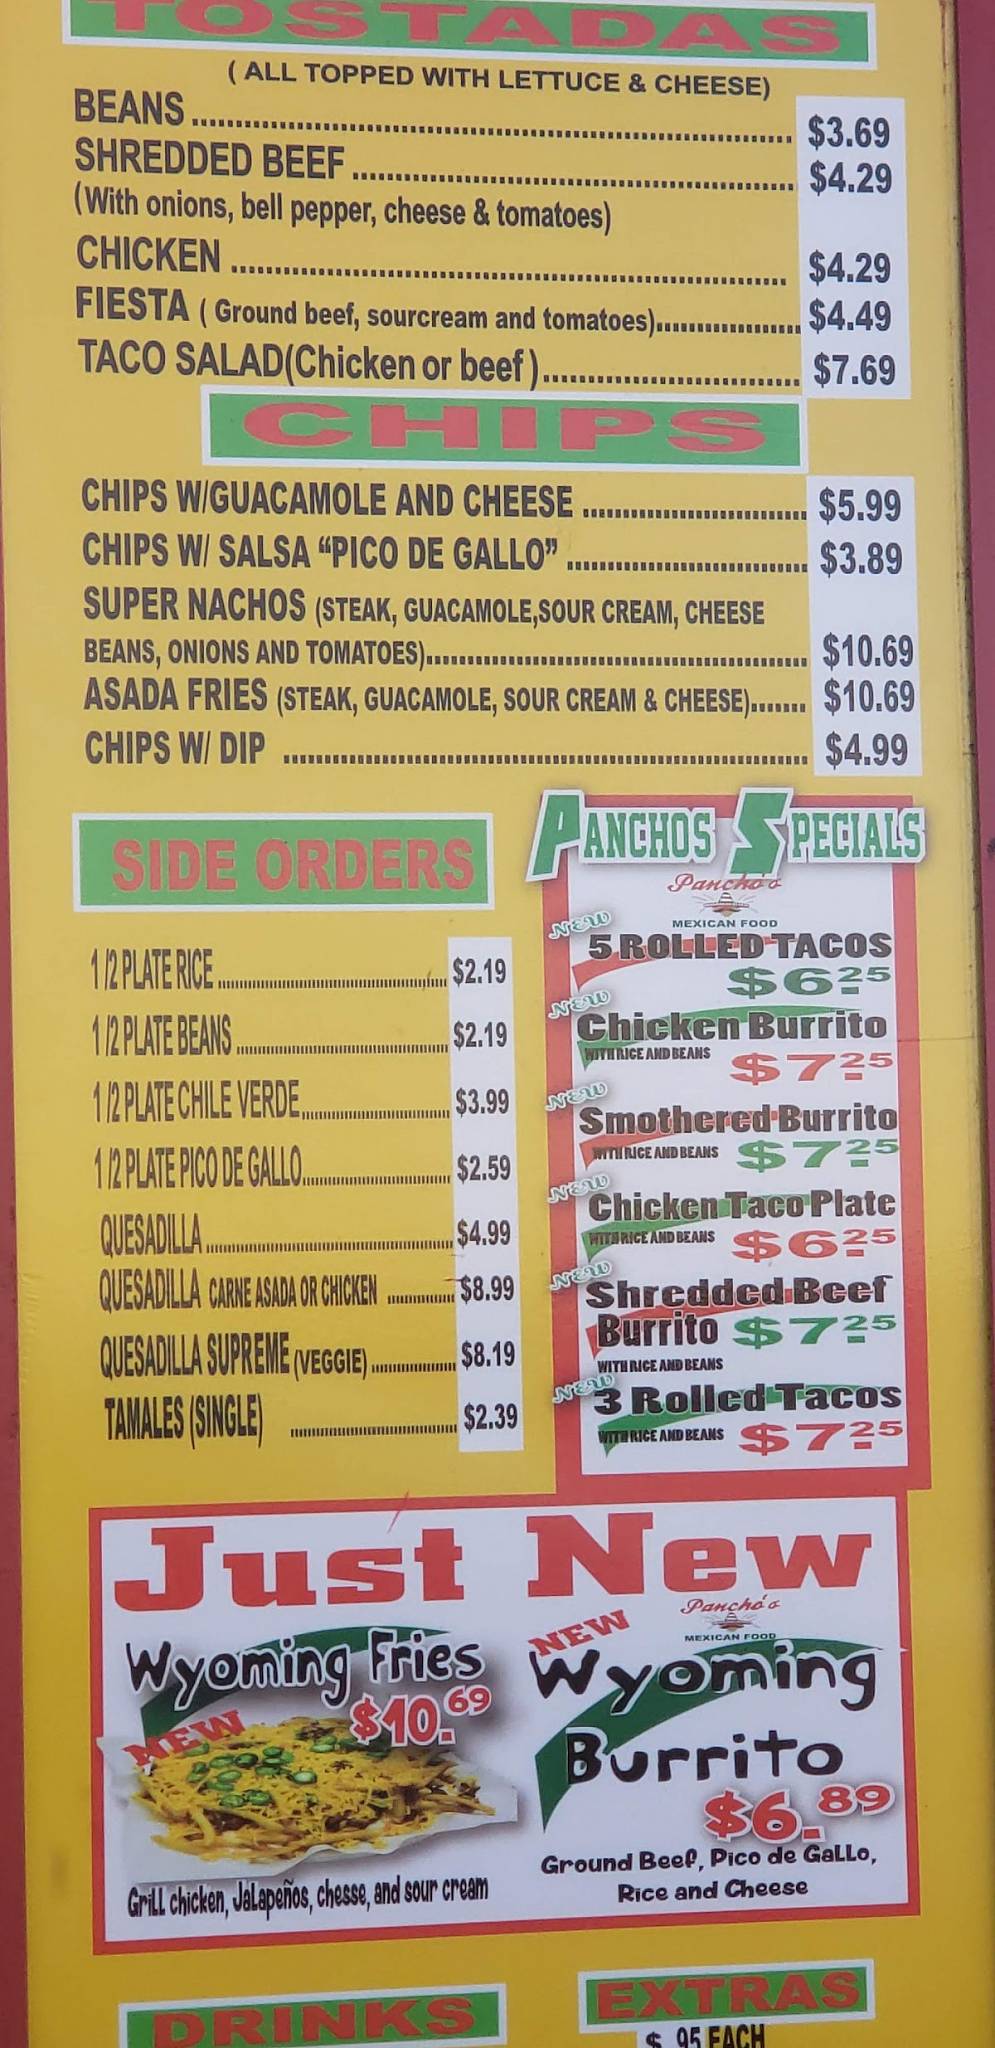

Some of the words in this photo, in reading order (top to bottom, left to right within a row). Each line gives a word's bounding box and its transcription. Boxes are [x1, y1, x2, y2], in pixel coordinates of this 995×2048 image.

[87, 0, 840, 53] TOSTADAS
[244, 61, 296, 81] ALL
[304, 63, 414, 85] TOPPED
[500, 70, 620, 92] LETTUCE
[655, 75, 770, 101] CHEESE)
[75, 88, 184, 126] BEANS
[808, 114, 889, 151] $3.69
[75, 137, 252, 176] SHREDDED
[263, 144, 344, 179] BEEF
[810, 160, 892, 196] $4.29
[75, 181, 138, 215] (With
[147, 189, 233, 224] onions,
[242, 191, 282, 220] bell
[291, 200, 376, 229] pepper,
[384, 196, 465, 225] cheese
[77, 235, 220, 272] CHICKEN
[809, 249, 890, 286] $4.29
[76, 286, 189, 321] FIESTA
[215, 299, 296, 324] Ground
[305, 301, 359, 331] beef,
[368, 309, 487, 328] sourcream
[496, 306, 535, 329] and
[809, 298, 891, 334] $4.49
[78, 339, 165, 375] TACO
[422, 356, 452, 380] or
[461, 348, 524, 382] beef
[814, 352, 895, 388] $7.69
[243, 402, 767, 454] CHIPS
[82, 478, 167, 512] CHIPS
[396, 484, 453, 516] AND
[464, 484, 573, 518] CHEESE
[819, 487, 901, 525] $5.99
[83, 532, 168, 567] CHIPS
[219, 534, 311, 568] SALSA
[409, 537, 443, 569] DE
[820, 540, 902, 578] $3.89
[84, 586, 179, 620] SUPER
[189, 588, 305, 621] NACHOS
[316, 597, 397, 628] (STEAK,
[602, 599, 678, 629] CREAM,
[685, 600, 764, 624] CHEESE
[85, 639, 160, 670] BEANS,
[168, 639, 249, 664] ONIONS
[256, 640, 299, 664] AND
[823, 632, 913, 671] $10.69
[84, 677, 179, 710] ASADA
[188, 678, 267, 711] FRIES
[278, 687, 357, 717] (STEAK,
[365, 687, 497, 717] GUACAMOLE,
[504, 688, 560, 711] SOUR
[566, 688, 636, 712] CREAM
[665, 688, 749, 719] CHEESE)
[824, 678, 914, 716] $10.69
[86, 731, 170, 764] CHIPS
[220, 731, 265, 764] DIP
[826, 731, 907, 770] $4.99
[533, 795, 711, 876] PANCHOS
[730, 793, 920, 874] SPECIALS
[112, 838, 237, 892] SIDE
[256, 837, 474, 890] ORDERS
[673, 920, 735, 928] MEXICAN
[588, 934, 612, 960] 5
[620, 934, 765, 960] ROLLED
[771, 932, 892, 959] TACOS
[123, 949, 172, 990] PLATE
[176, 948, 213, 990] RICE
[453, 957, 506, 987] $2.19
[124, 1015, 173, 1056] PLATE
[178, 1014, 231, 1055] BEANS
[454, 1021, 507, 1051] $2.19
[577, 1013, 740, 1042] Chicken
[749, 1011, 887, 1040] Burrito
[125, 1081, 174, 1122] PLATE
[178, 1080, 232, 1119] CHILE
[237, 1080, 300, 1118] VERDE
[456, 1088, 509, 1118] $3.99
[579, 1106, 771, 1134] Smothered
[779, 1103, 898, 1132] Burrito
[126, 1147, 175, 1189] PLATE
[180, 1146, 217, 1188] PICO
[223, 1146, 243, 1187] DE
[248, 1145, 301, 1187] GALLO
[457, 1154, 510, 1184] $2.59
[589, 1192, 718, 1222] Chicken
[725, 1191, 804, 1217] Taco
[811, 1189, 895, 1217] Plate
[101, 1213, 202, 1259] QUESADILLA
[457, 1219, 510, 1249] $4.99
[100, 1268, 201, 1314] QUESADILLA
[209, 1277, 251, 1309] CARNE
[255, 1276, 297, 1307] ASADA
[301, 1276, 317, 1307] OR
[321, 1275, 377, 1306] CHICKEN
[457, 1275, 514, 1304] $8.99
[586, 1277, 784, 1309] Shredded
[793, 1275, 893, 1304] Beef
[598, 1313, 718, 1347] Burrito
[101, 1334, 202, 1380] QUESADILLA
[207, 1332, 289, 1375] SUPREME
[294, 1348, 367, 1381] (VEGGIE)
[462, 1341, 515, 1370] $8.19
[629, 1359, 657, 1372] RICE
[659, 1358, 683, 1371] AND
[685, 1358, 723, 1371] BEANS
[464, 1403, 517, 1433] $2.39
[595, 1389, 622, 1415] 3
[632, 1384, 765, 1413] Rolled
[775, 1383, 902, 1411] Tacos
[105, 1395, 184, 1440] TAMALES
[190, 1393, 262, 1449] (SINGLE)
[115, 1526, 464, 1612] Just
[526, 1512, 872, 1598] New
[527, 1609, 631, 1657] NEW
[741, 1633, 779, 1644] FOOD
[126, 1638, 348, 1707] Wyoming
[371, 1632, 484, 1682] Fries
[528, 1640, 877, 1713] Wyoming
[121, 1709, 246, 1767] NEW
[567, 1729, 844, 1784] Burrito
[541, 1853, 632, 1874] Ground
[711, 1848, 760, 1867] Pico
[767, 1844, 796, 1864] de
[170, 1885, 228, 1918] chicken,
[317, 1878, 370, 1912] chesse,
[374, 1877, 400, 1904] and
[404, 1880, 438, 1902] sour
[442, 1878, 488, 1901] cream
[618, 1884, 668, 1903] Rice
[675, 1881, 718, 1900] and
[725, 1879, 808, 1898] Cheese
[596, 1969, 860, 2020] EXTRAS
[153, 1997, 475, 2048] DRINKS
